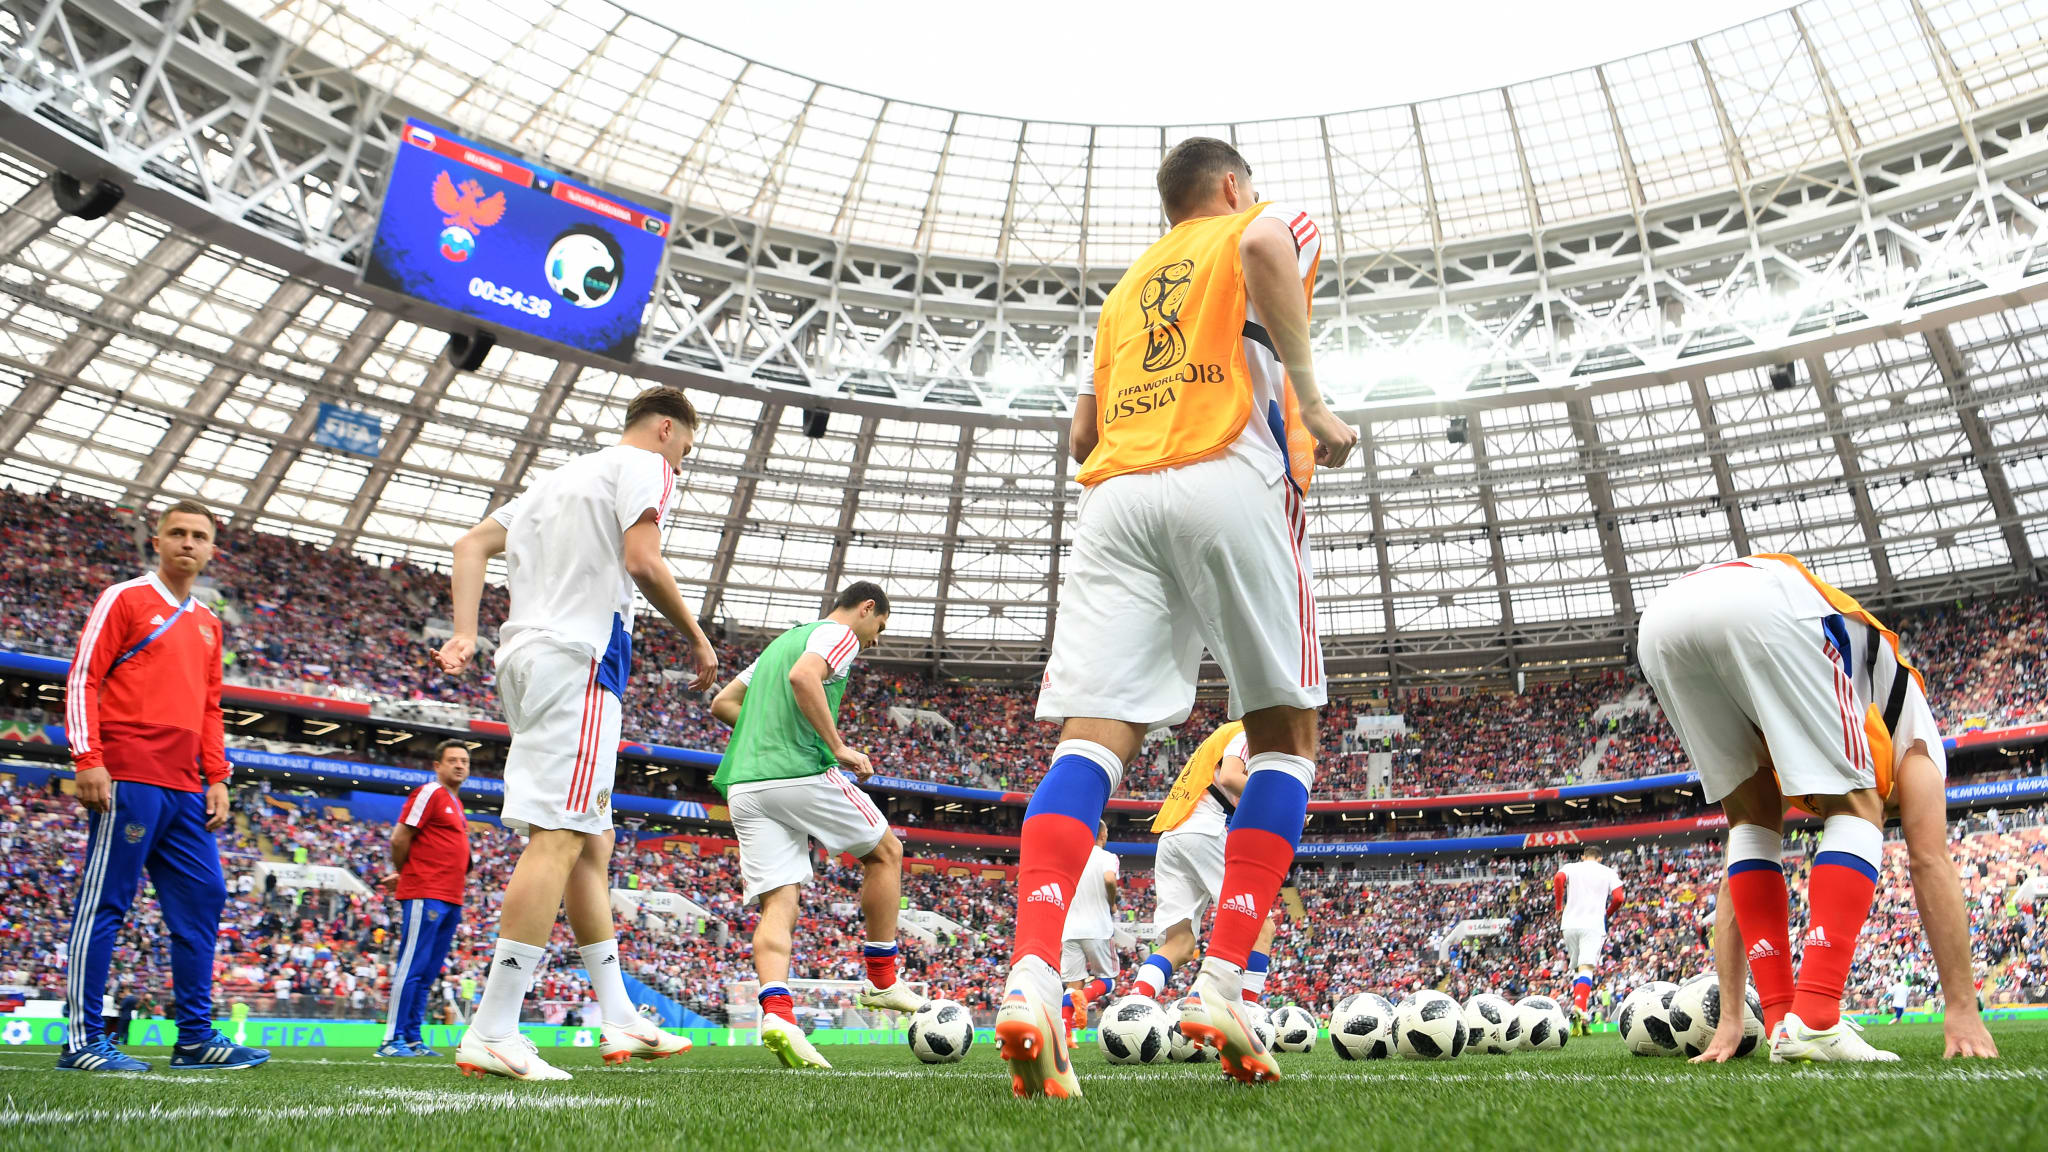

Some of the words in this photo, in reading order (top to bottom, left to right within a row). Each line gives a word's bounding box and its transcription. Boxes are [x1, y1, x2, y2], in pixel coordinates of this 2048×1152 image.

[468, 276, 553, 319] 00:54:38
[1117, 384, 1142, 399] FIFA
[1143, 371, 1184, 392] WORLD
[1336, 844, 1369, 853] RUSSIA
[1026, 894, 1066, 911] adidas
[1222, 903, 1258, 920] adidas
[1748, 949, 1781, 961] adidas
[262, 1025, 326, 1046] FIFA
